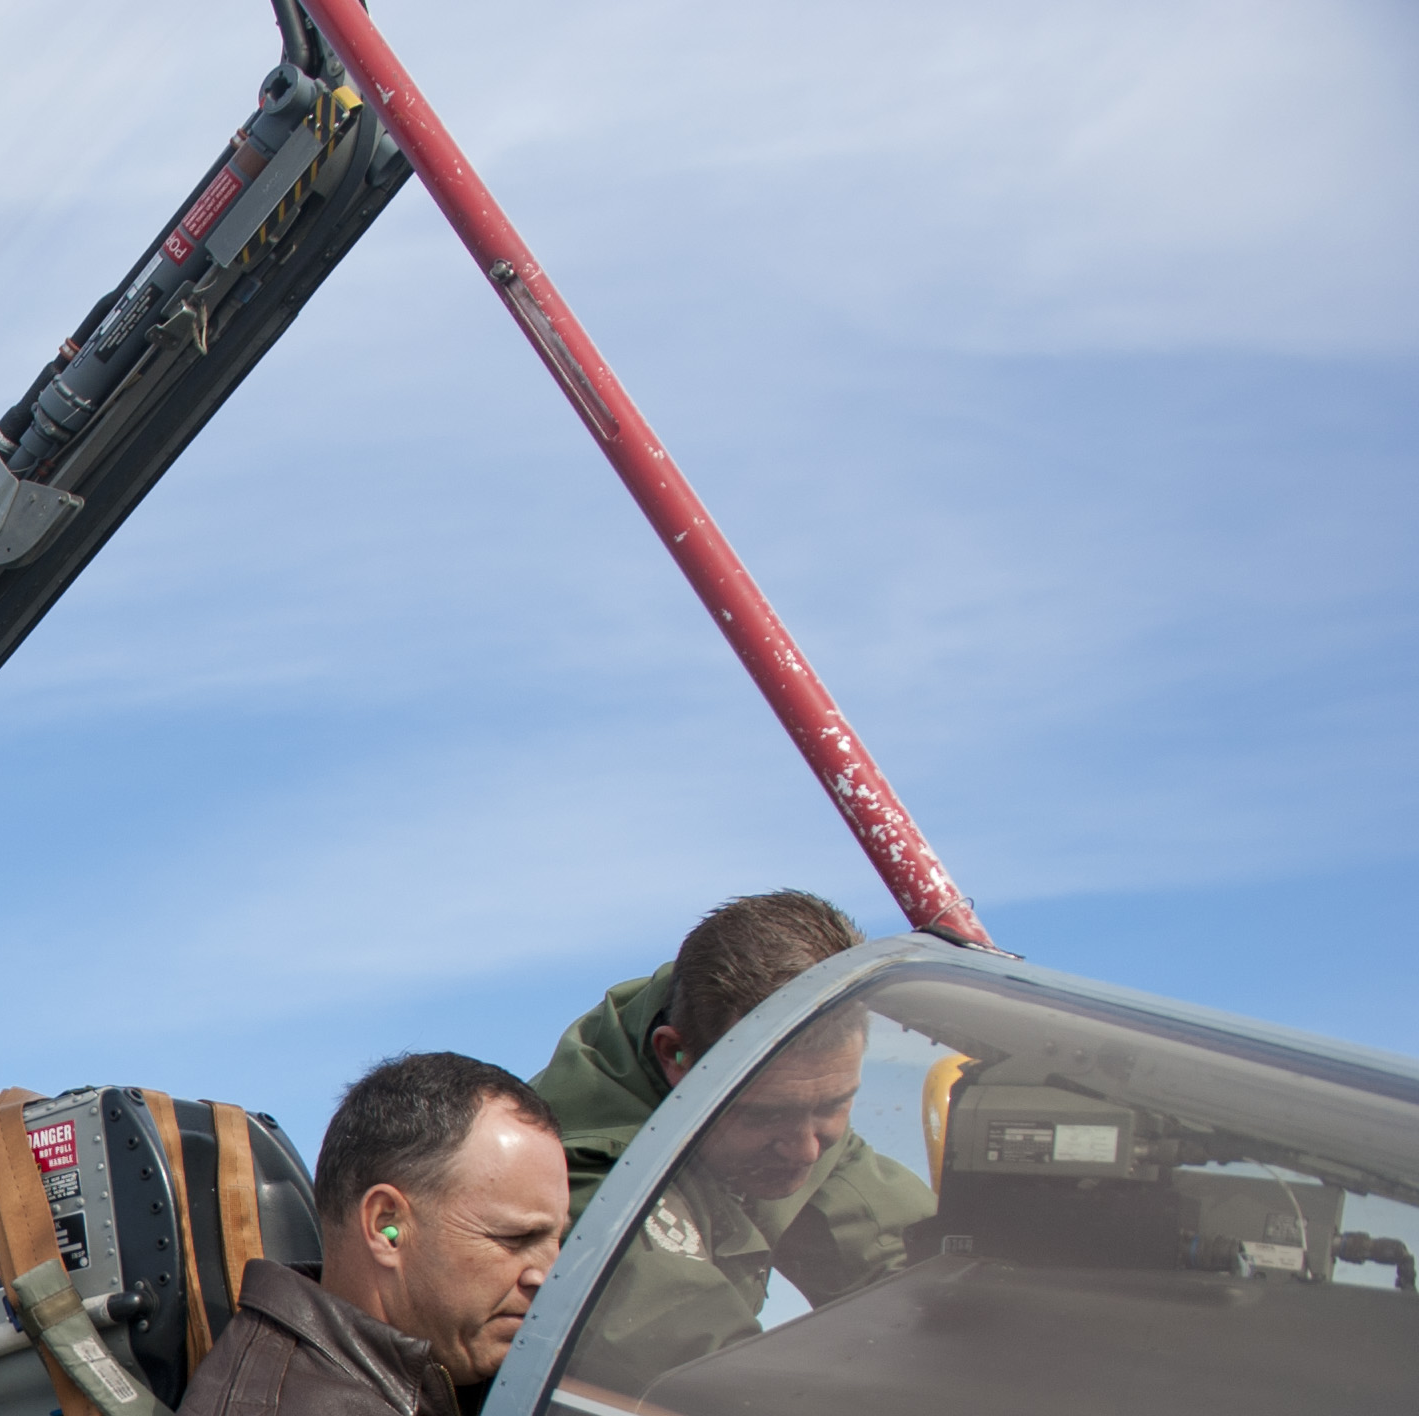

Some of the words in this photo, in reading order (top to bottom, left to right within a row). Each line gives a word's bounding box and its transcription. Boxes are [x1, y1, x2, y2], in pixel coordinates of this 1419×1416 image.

[39, 1147, 53, 1159] NOT
[55, 1143, 72, 1155] PULL
[48, 1154, 74, 1168] HANDLE
